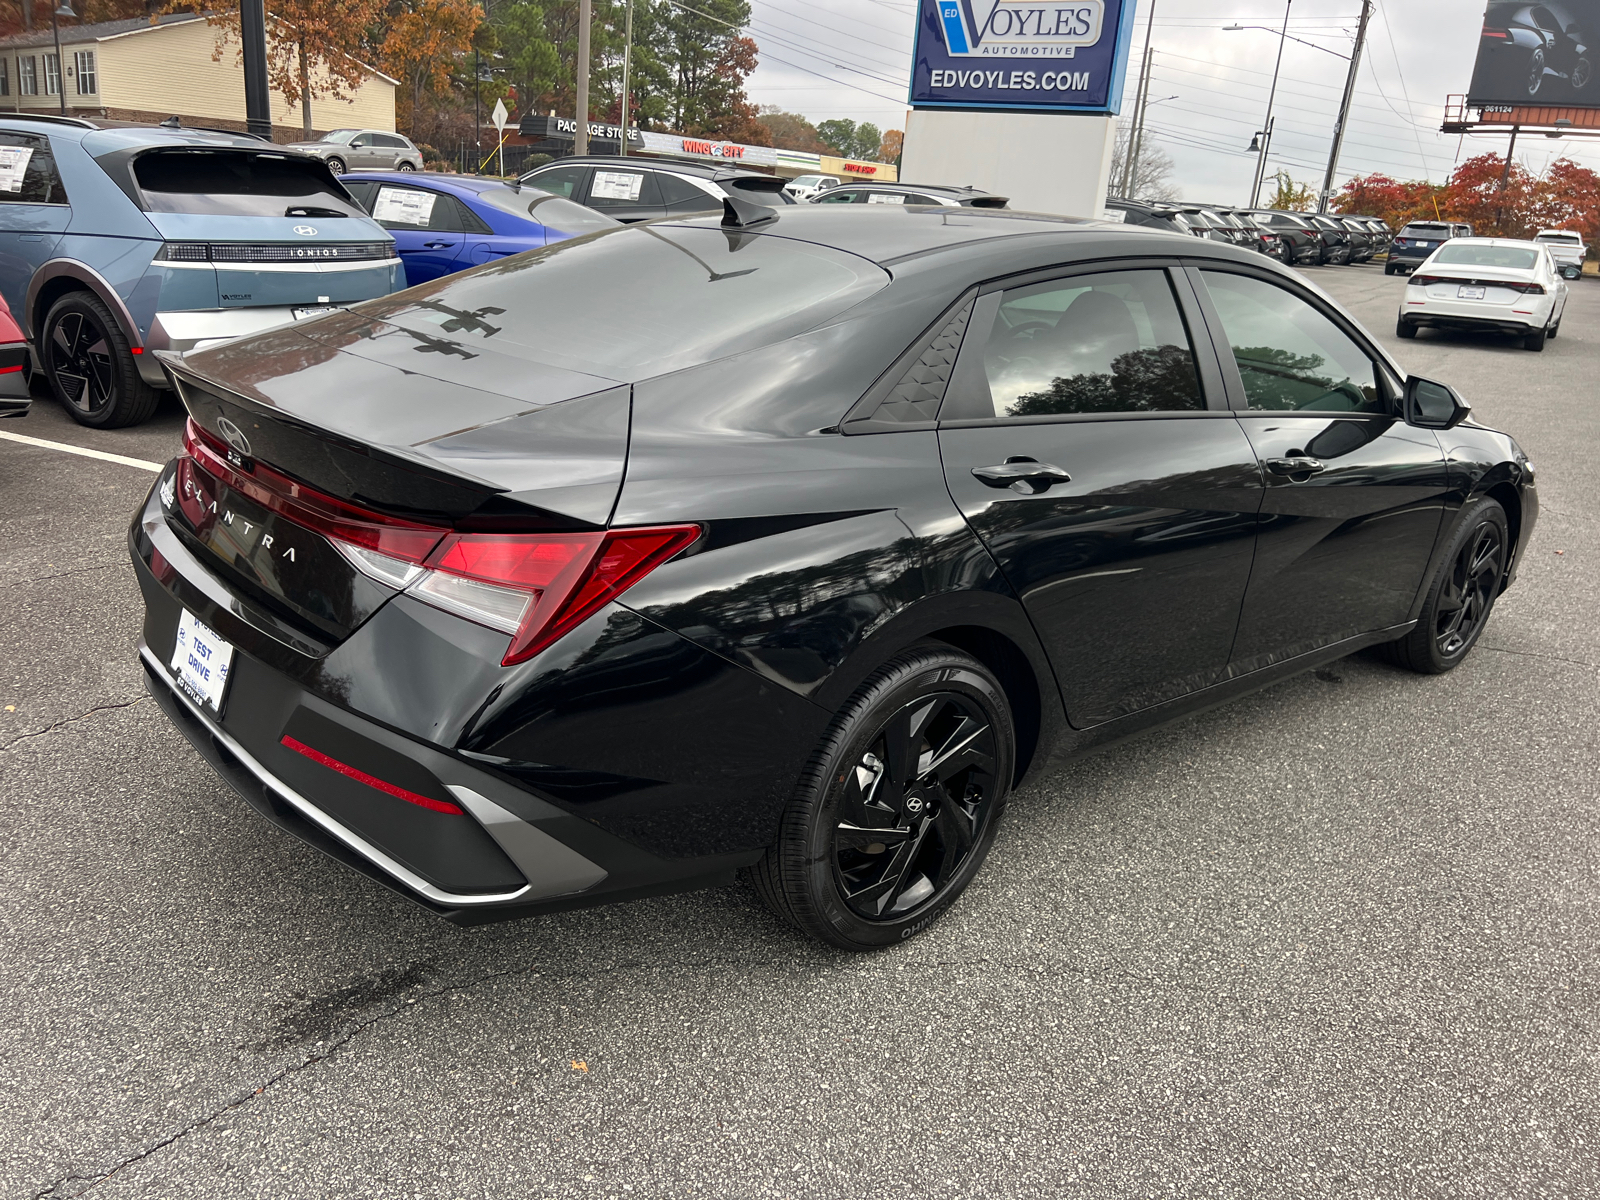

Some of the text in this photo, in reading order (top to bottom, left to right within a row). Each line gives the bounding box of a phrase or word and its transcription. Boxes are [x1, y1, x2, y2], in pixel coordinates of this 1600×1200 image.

[944, 8, 958, 18] ED
[960, 0, 1092, 48] VOYLES
[982, 46, 1073, 56] AUTOMOTIVE
[930, 69, 1090, 91] EDVOYLES.COM
[557, 119, 605, 137] PACAGE
[683, 139, 745, 158] WING CITY
[844, 163, 859, 173] STOP
[862, 166, 877, 175] SHOP
[184, 479, 296, 563] ELANTRA
[193, 636, 213, 661] TEST
[188, 652, 210, 682] DRIVE
[176, 675, 202, 706] ED VOYLES
[901, 900, 951, 939] KUMHO
